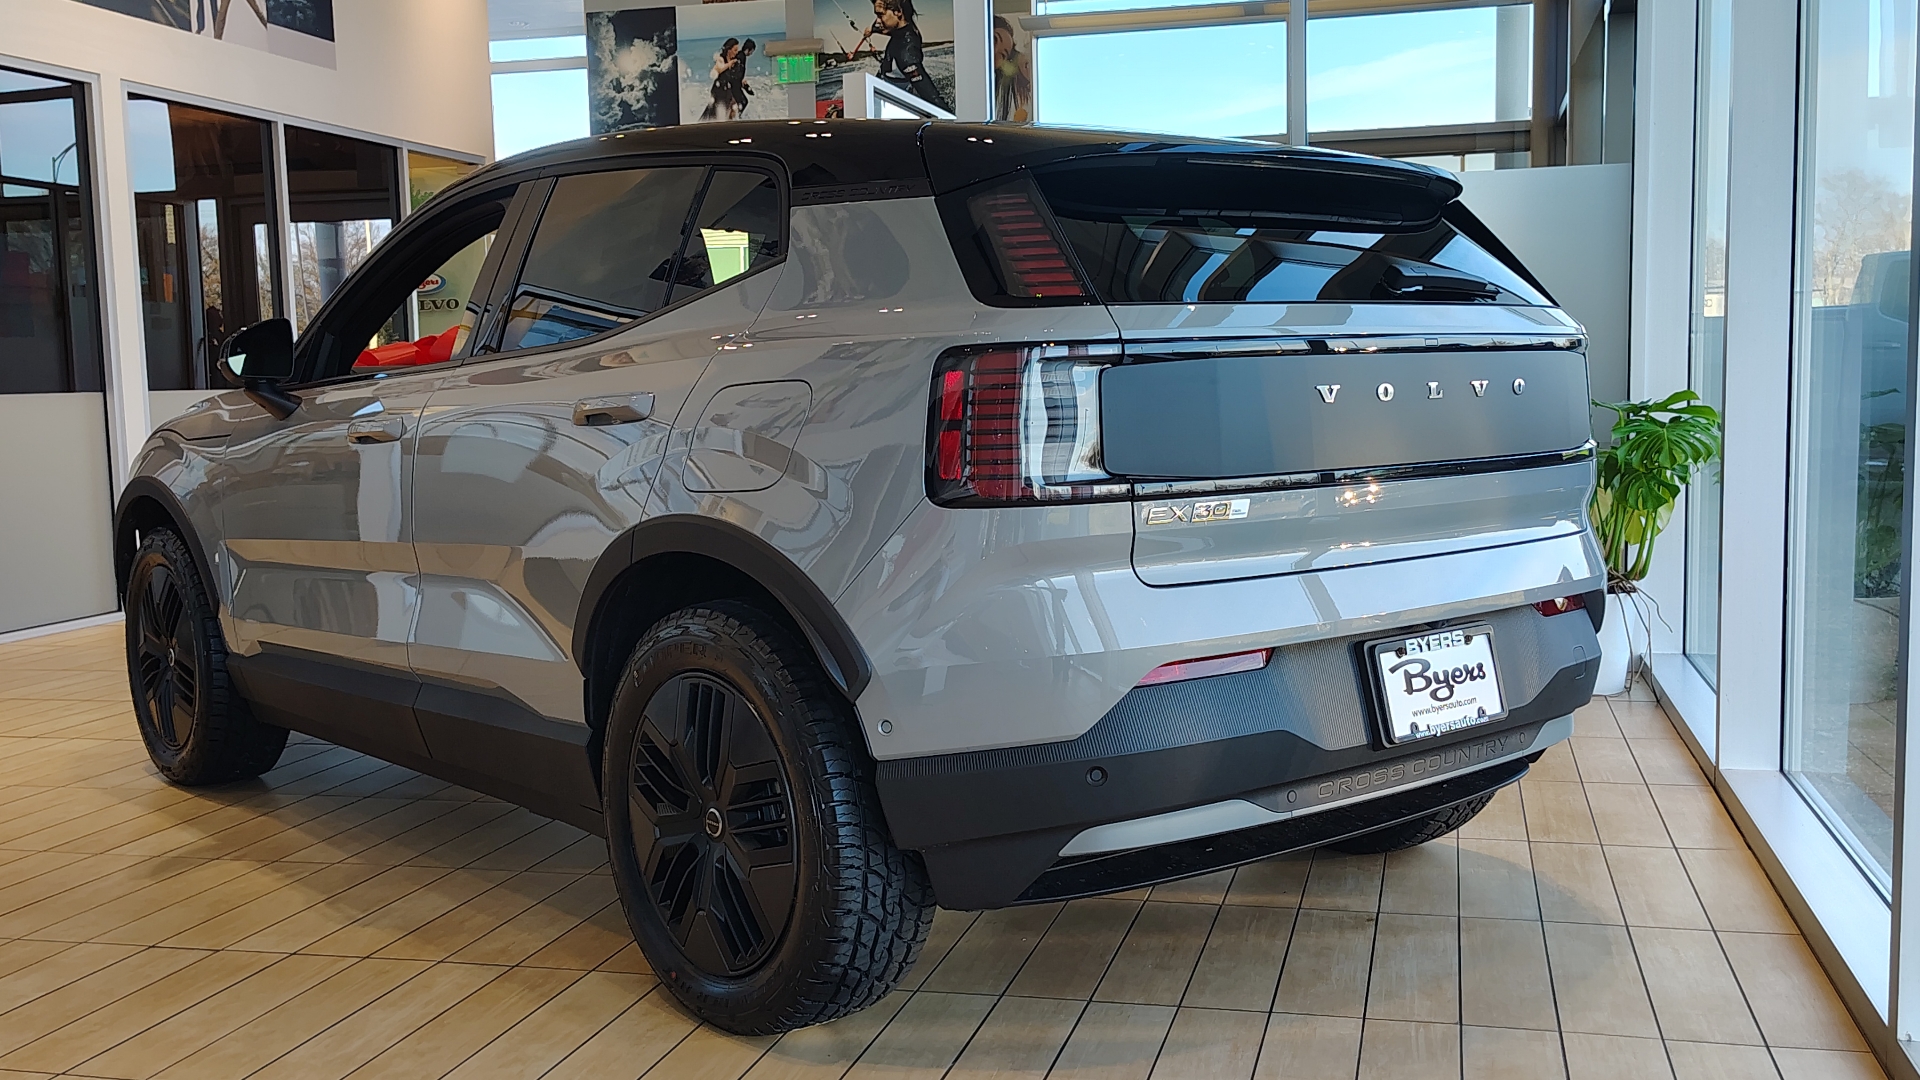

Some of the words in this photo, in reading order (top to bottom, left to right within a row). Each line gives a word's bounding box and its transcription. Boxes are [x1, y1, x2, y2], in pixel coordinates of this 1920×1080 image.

[419, 298, 460, 311] LVO
[1315, 377, 1526, 404] VOLVO
[1404, 630, 1464, 656] BYERS
[1388, 658, 1486, 702] Byers
[1411, 697, 1478, 718] www.byersauto.com
[1415, 715, 1490, 739] www.byersauto.com
[1317, 763, 1405, 799] CROSS
[1412, 735, 1509, 775] COUNTRY
